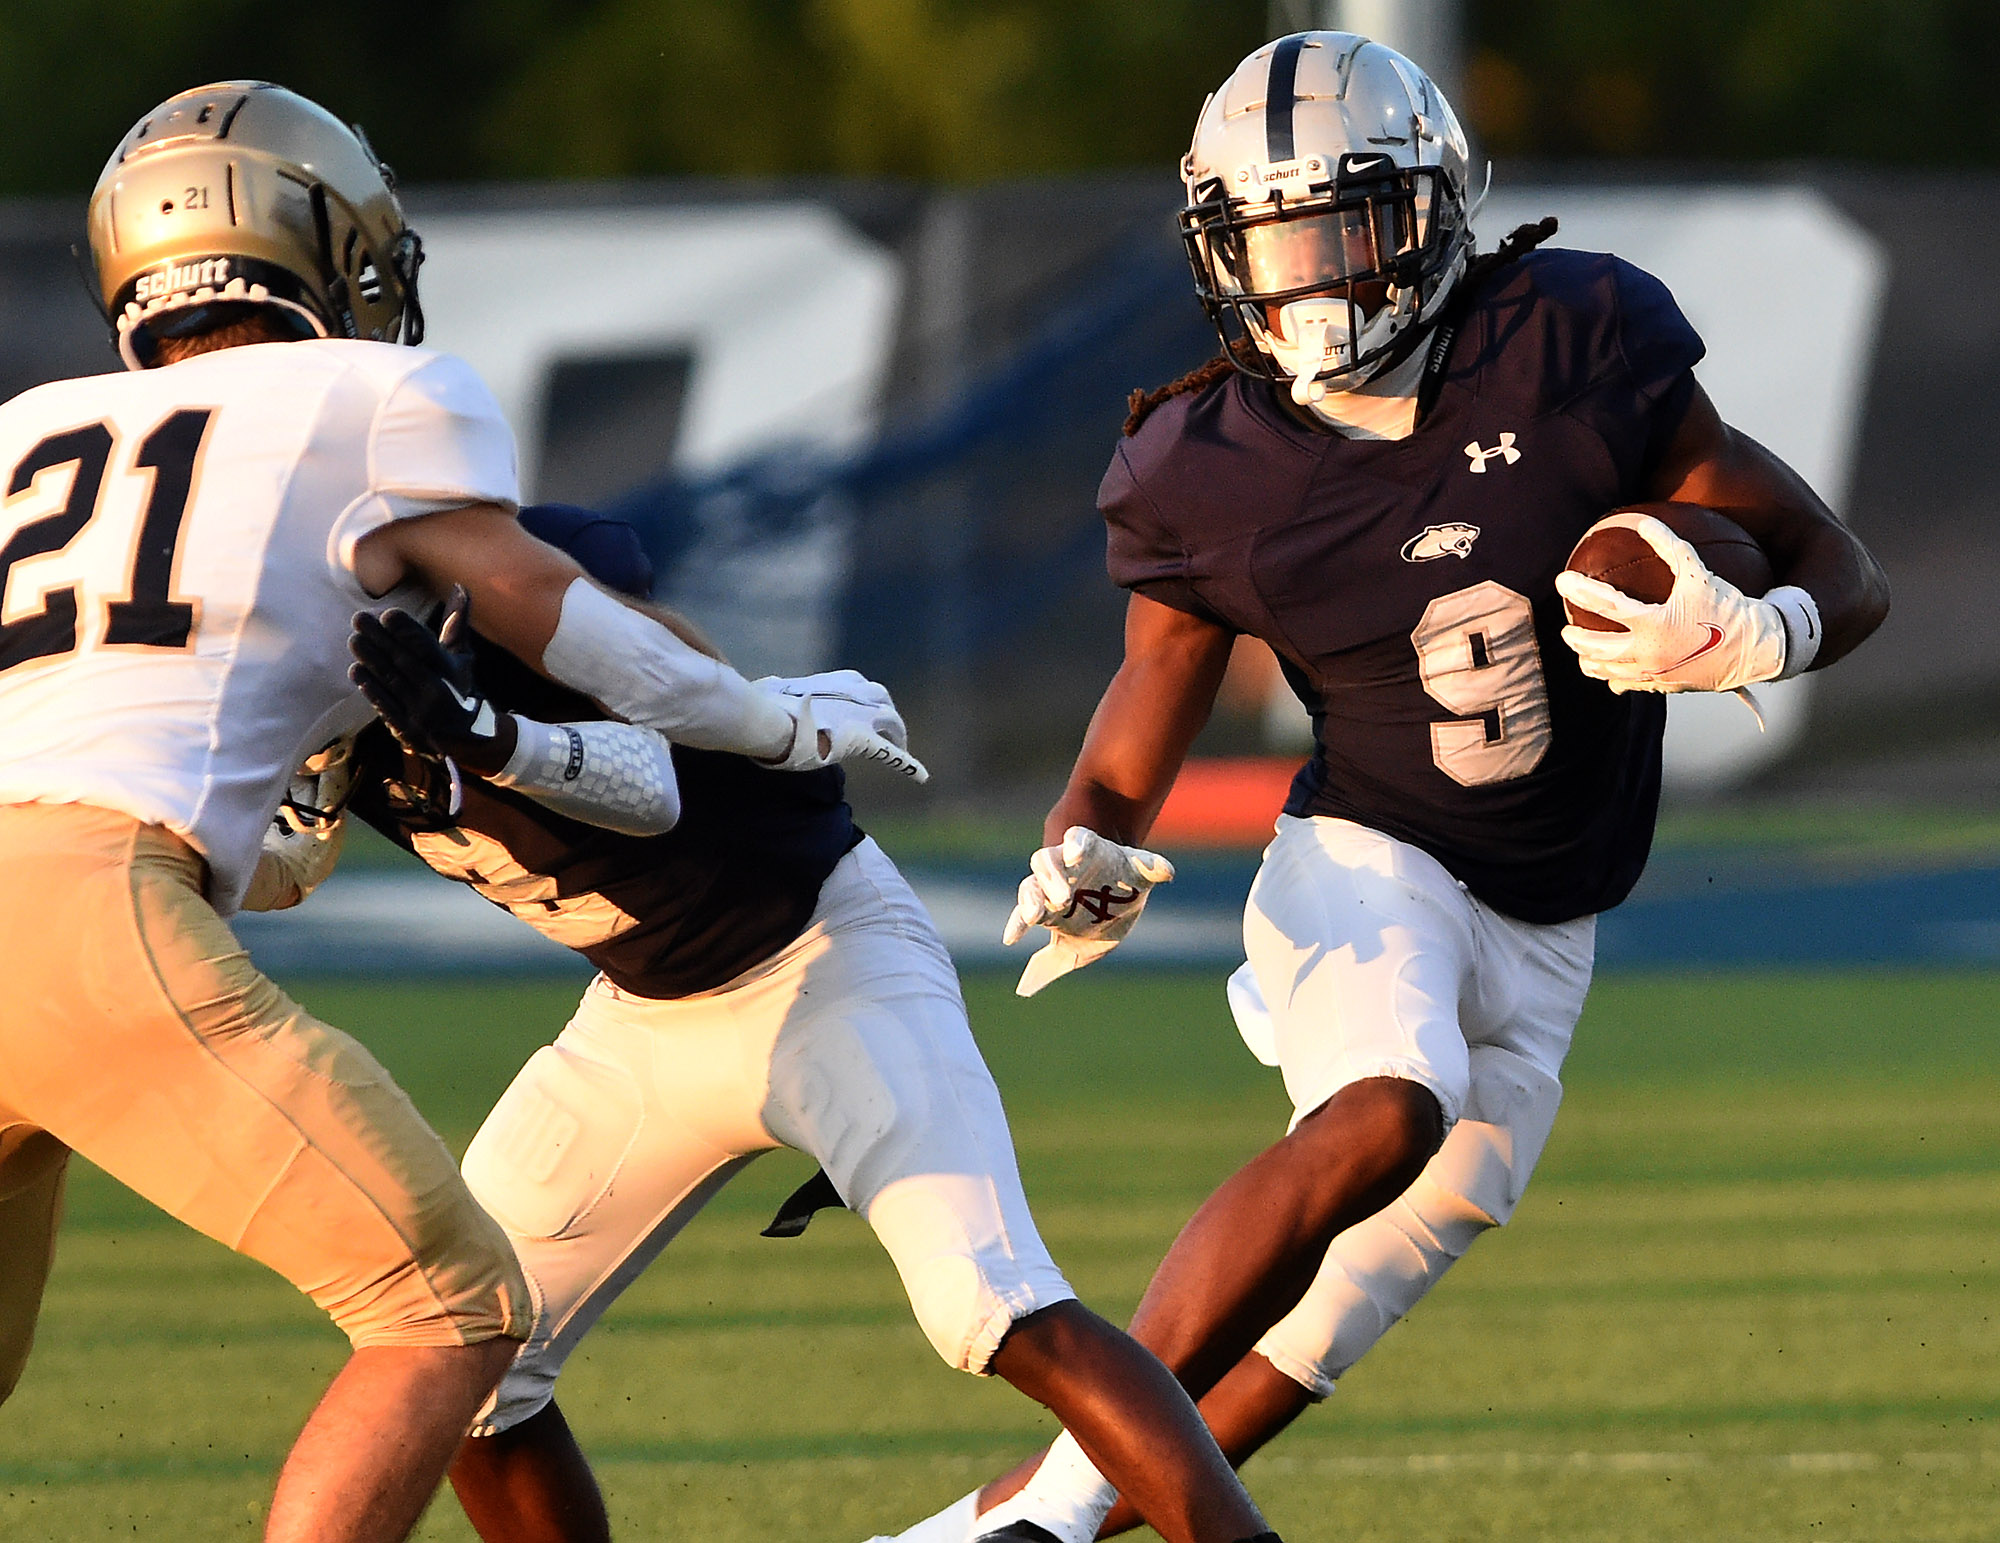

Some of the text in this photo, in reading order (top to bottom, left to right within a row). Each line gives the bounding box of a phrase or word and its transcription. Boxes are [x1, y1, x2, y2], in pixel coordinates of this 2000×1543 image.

[1263, 168, 1300, 182] schutt
[184, 187, 209, 210] 21
[135, 255, 231, 301] schutt
[0, 404, 222, 677] 21
[1410, 579, 1552, 787] 9
